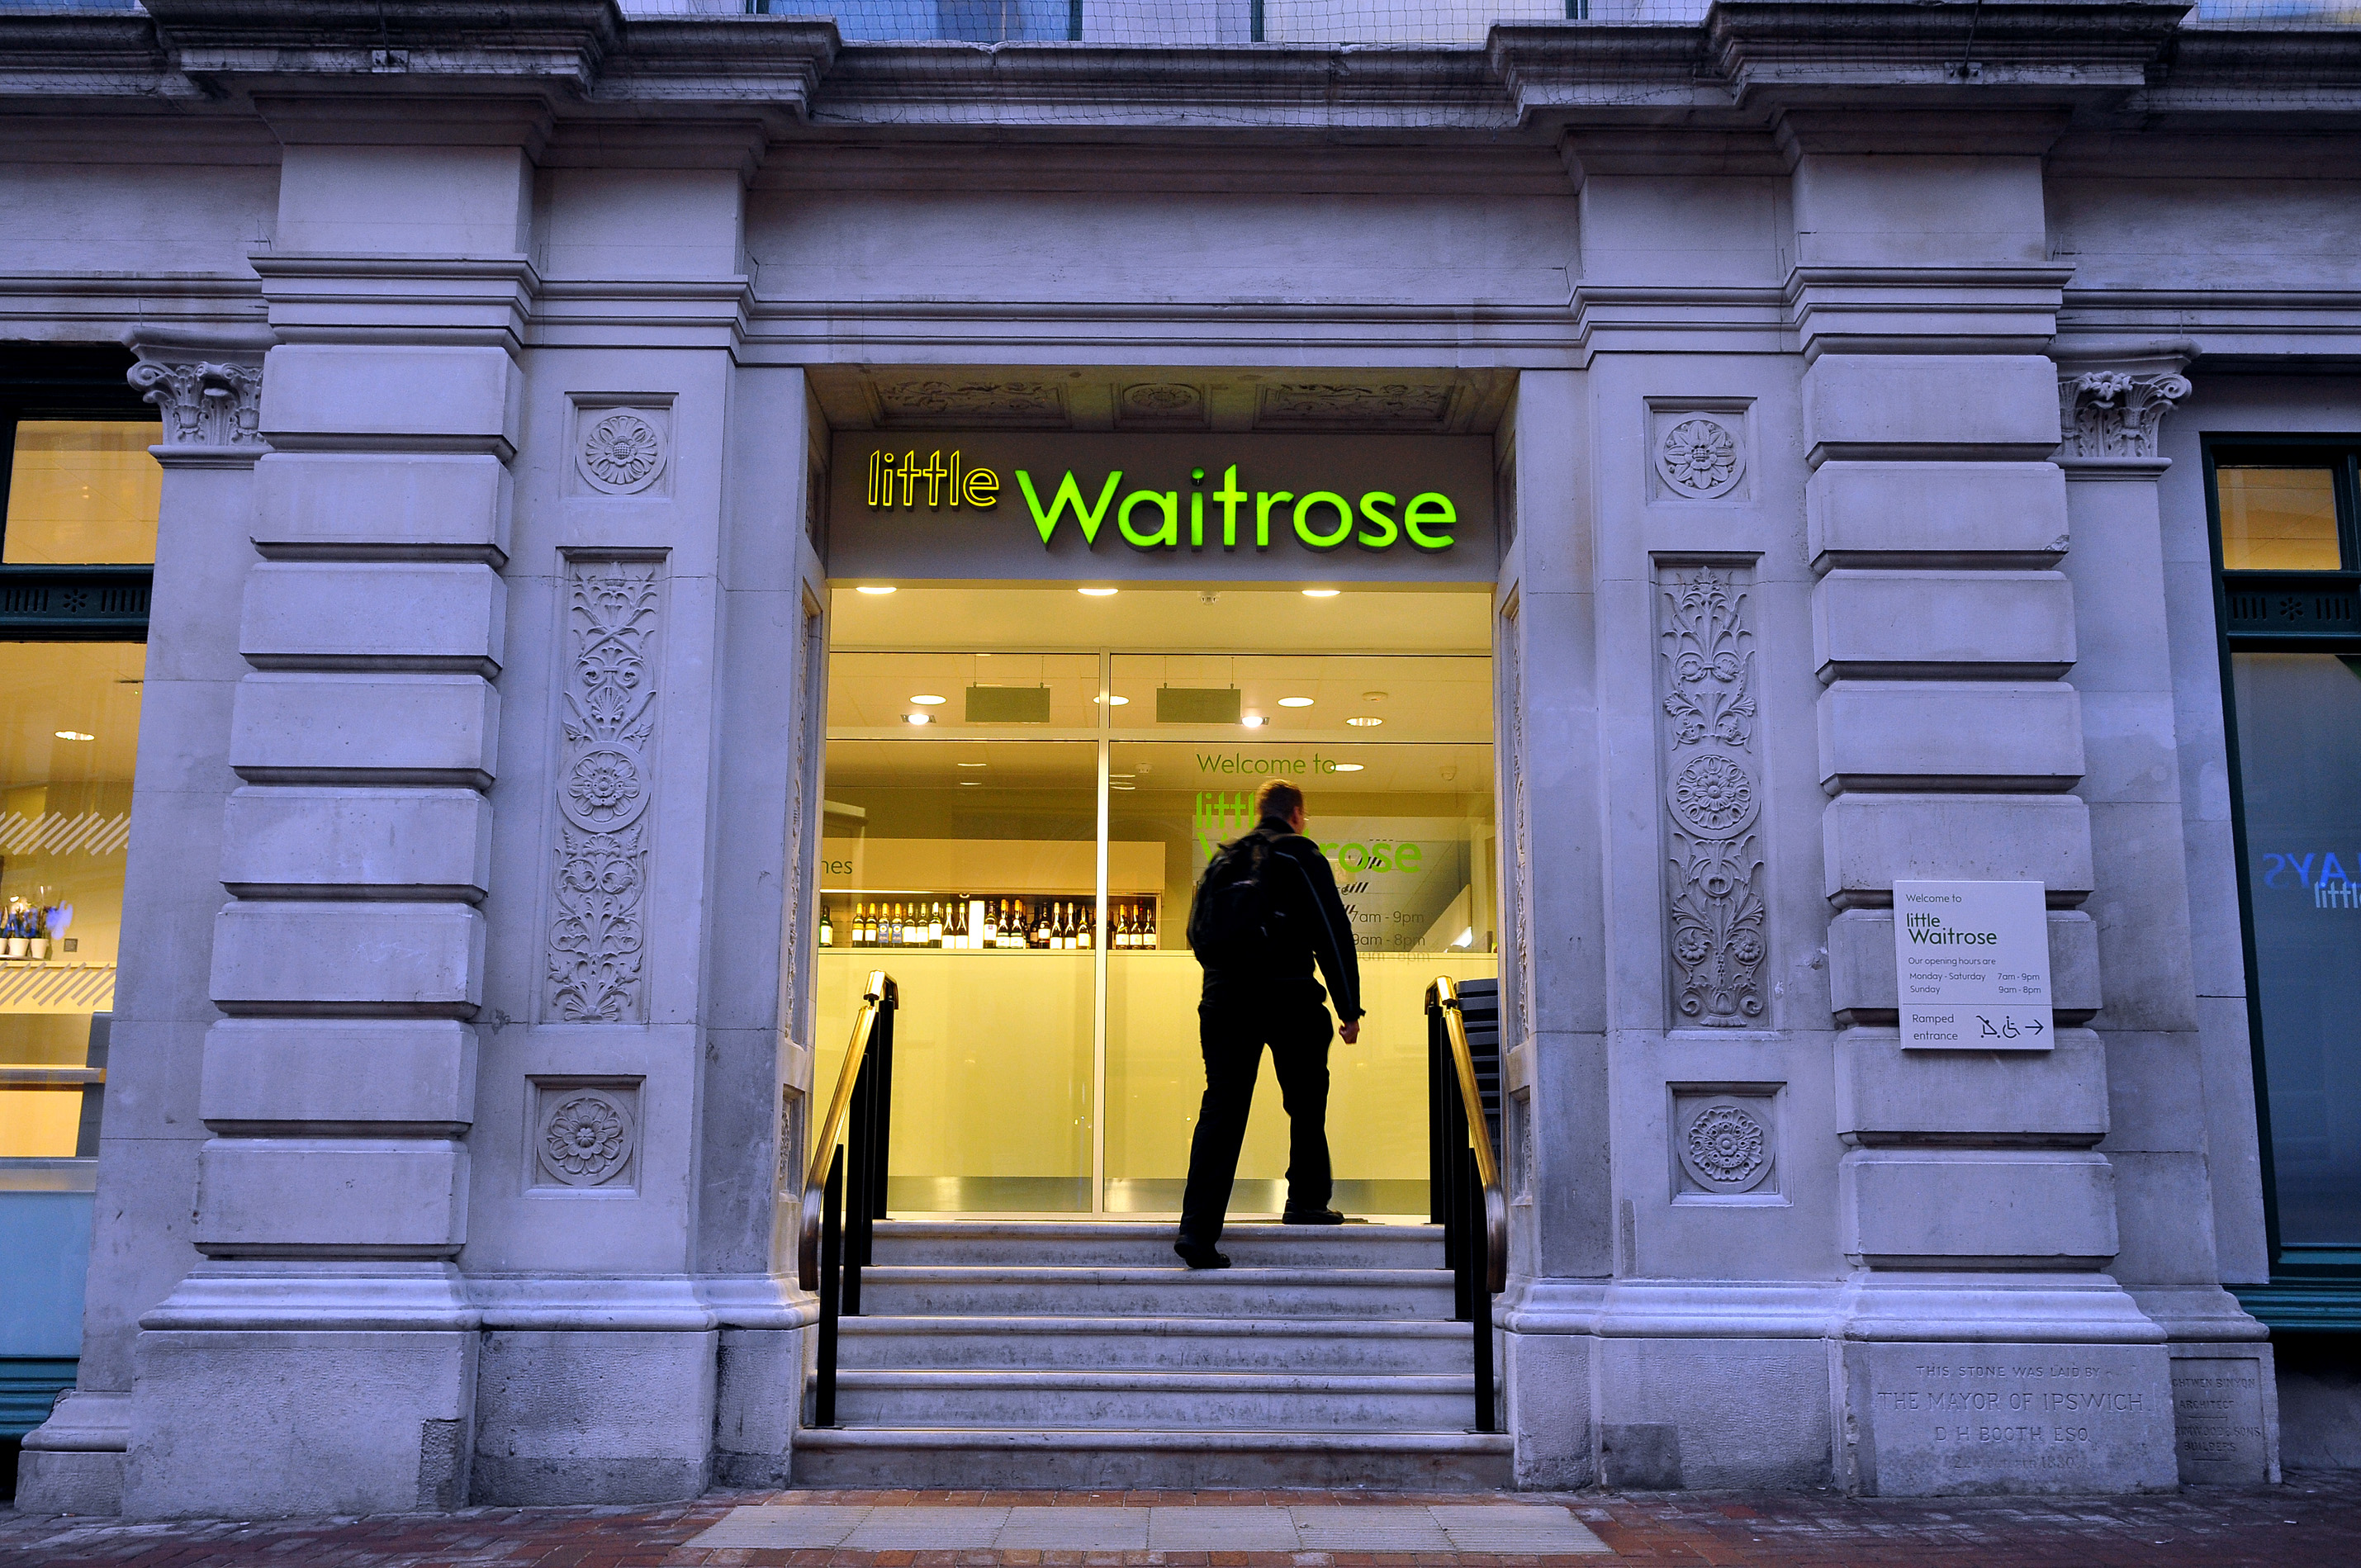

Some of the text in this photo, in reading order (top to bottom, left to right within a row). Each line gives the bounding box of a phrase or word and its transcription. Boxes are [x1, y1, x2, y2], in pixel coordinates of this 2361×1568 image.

[868, 450, 1458, 548] little Waitrose
[1197, 753, 1336, 775] Welcome to
[1197, 792, 1255, 829] littl
[1906, 894, 1962, 902] Welcome to
[2314, 881, 2361, 908] littl
[1351, 911, 1382, 923] 7am
[1393, 911, 1424, 926] 9pm
[1907, 912, 1941, 927] little
[1394, 934, 1425, 950] 8pm
[1908, 927, 1997, 945] Waitrose
[1924, 958, 1957, 967] opening
[1909, 973, 1943, 982] Monday
[1949, 973, 1986, 982] Saturday
[2022, 973, 2041, 983] 9pm
[1910, 985, 1941, 995] Sunday
[2023, 986, 2041, 996] 8pm
[1912, 1014, 1955, 1026] Ramped
[1913, 1031, 1958, 1040] entrance
[1916, 1366, 2101, 1378] THIS STONE WAS LAID BY
[1877, 1392, 2144, 1412] THE MAYOR OF IPSWICH
[1935, 1427, 1947, 1441] D
[1957, 1427, 1970, 1441] H
[1979, 1427, 2041, 1442] BOOTH
